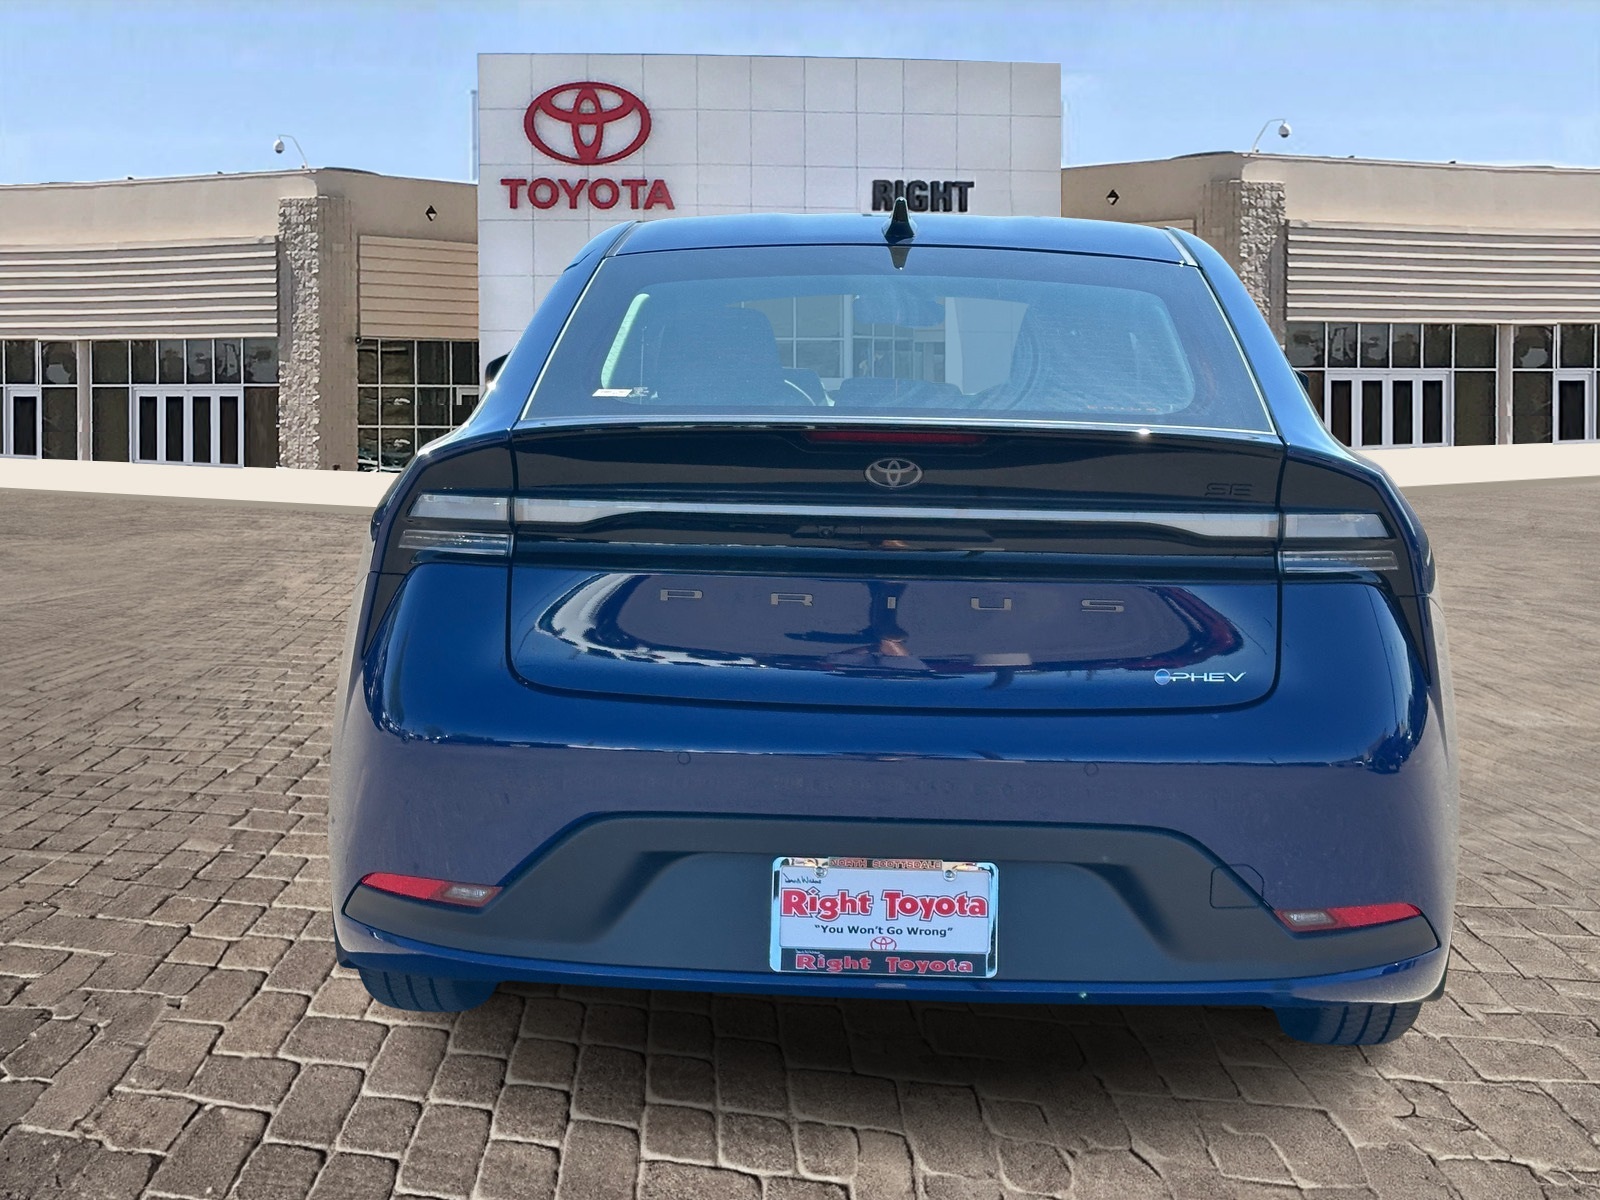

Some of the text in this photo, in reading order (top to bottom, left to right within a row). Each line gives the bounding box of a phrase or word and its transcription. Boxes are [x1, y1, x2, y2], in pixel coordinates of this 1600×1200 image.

[500, 178, 675, 210] TOYOTA
[872, 179, 975, 212] RIGHT
[1205, 482, 1252, 496] SE
[660, 588, 1125, 613] PRIUS
[1170, 671, 1246, 683] PHEV
[830, 858, 942, 869] NORTH SCOTTSDALE
[781, 887, 989, 922] Right Toyota
[847, 925, 883, 936] Won't
[886, 926, 904, 936] Go
[795, 953, 974, 974] Right Toyota
